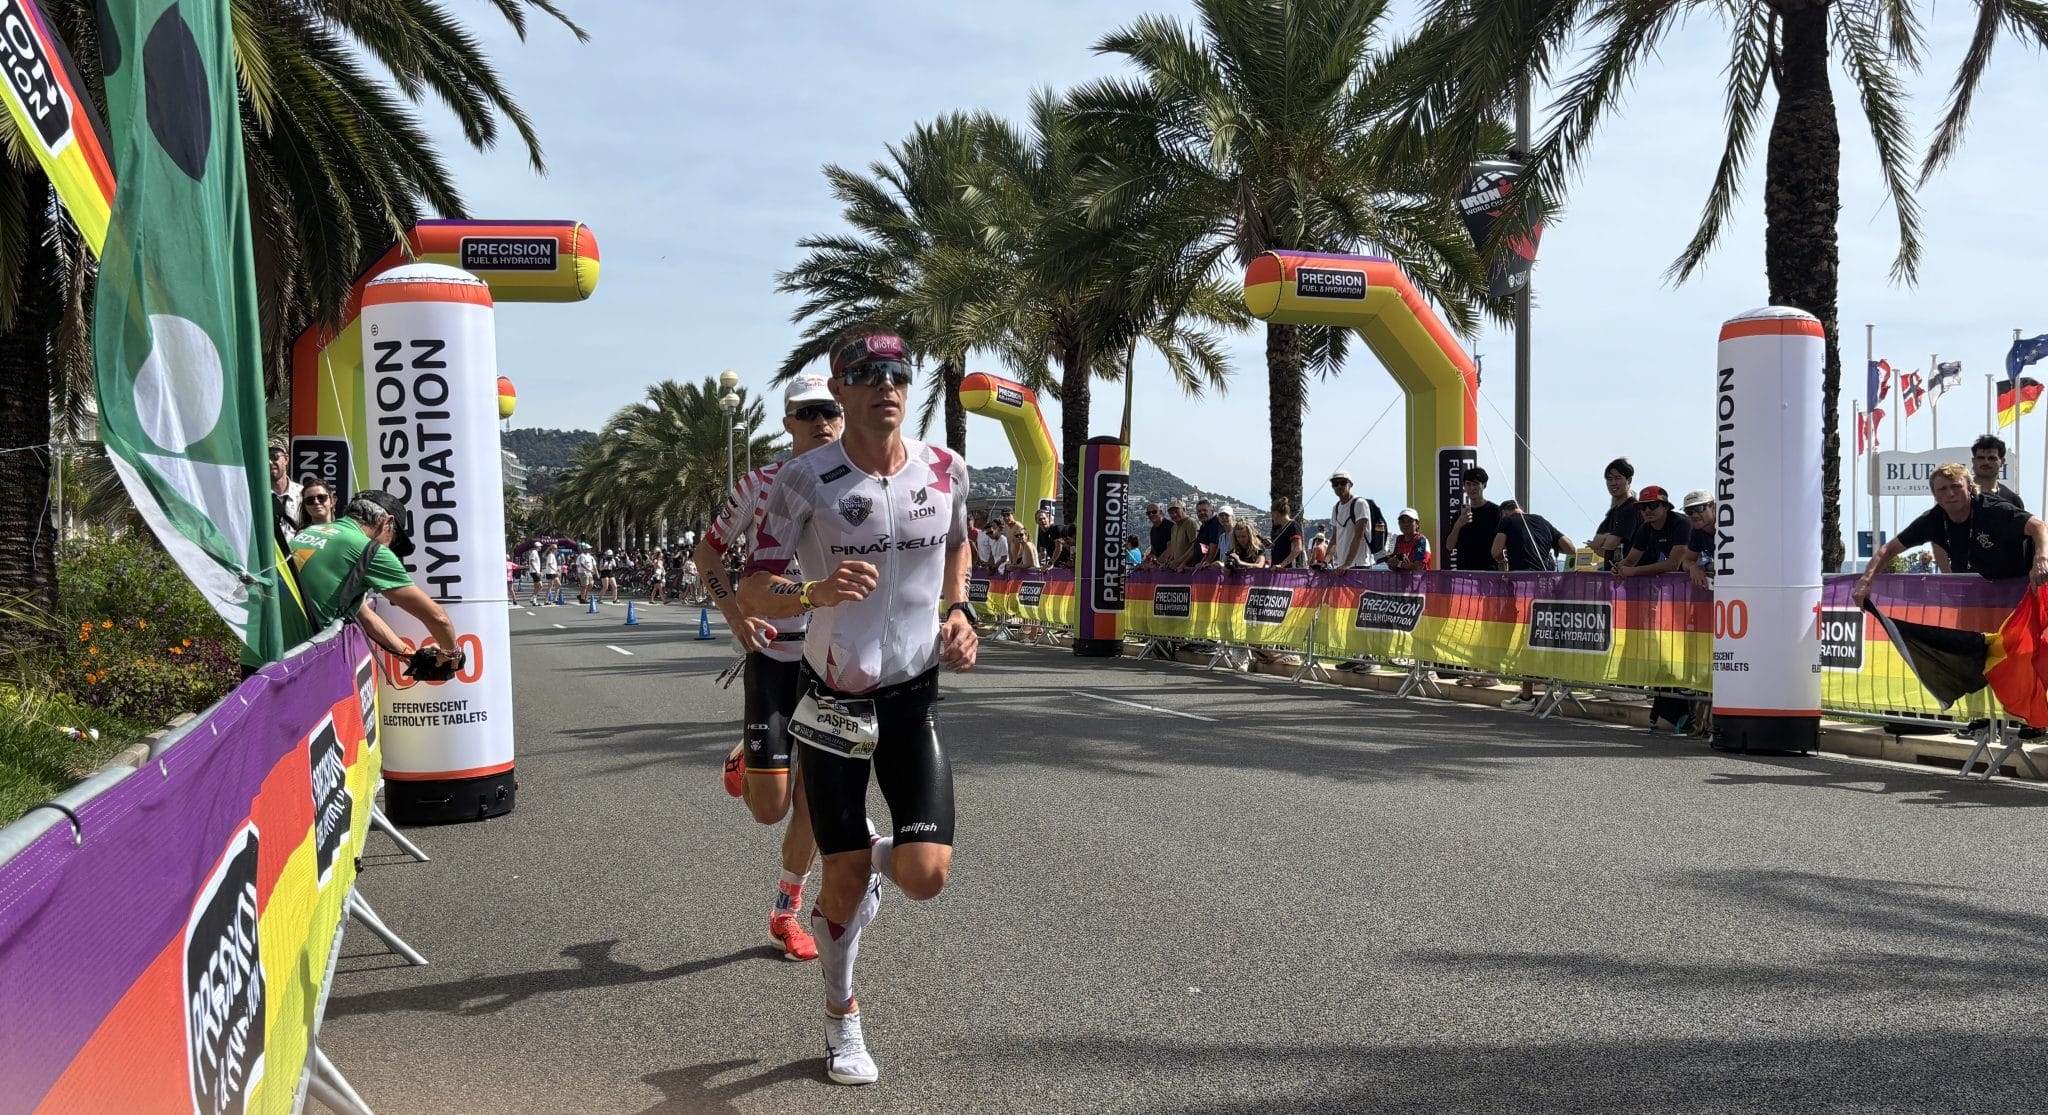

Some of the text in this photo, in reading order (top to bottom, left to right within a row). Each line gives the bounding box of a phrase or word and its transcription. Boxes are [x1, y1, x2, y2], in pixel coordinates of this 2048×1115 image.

[1460, 188, 1502, 210] IRON
[1465, 203, 1491, 216] WORLD
[467, 243, 551, 256] PRECISION
[467, 256, 551, 265] FUEL & HYDRATION
[1301, 273, 1362, 286] PRECISION
[1324, 286, 1362, 295] HYDRATION
[410, 339, 463, 604] HYDRATION
[1449, 459, 1459, 494] FUEL
[1718, 367, 1735, 576] HYDRATION
[1449, 498, 1459, 507] &
[908, 505, 936, 520] IRON
[1120, 483, 1129, 556] HYDRATION
[294, 533, 328, 550] EDIA
[1103, 482, 1122, 602] PRECISION
[1155, 591, 1189, 603] PRECISION
[1247, 594, 1289, 609] PRECISION
[1362, 598, 1421, 617] PRECISION
[1536, 611, 1606, 630] PRECISION
[1535, 630, 1605, 643] FUEL & HYDRATION
[1719, 662, 1749, 672] TABLETS
[392, 700, 469, 714] EFFERVESCENT
[383, 714, 440, 727] ELECTROLYTE
[441, 711, 488, 726] TABLETS
[817, 713, 859, 734] CASPER
[900, 822, 937, 834] sailfish
